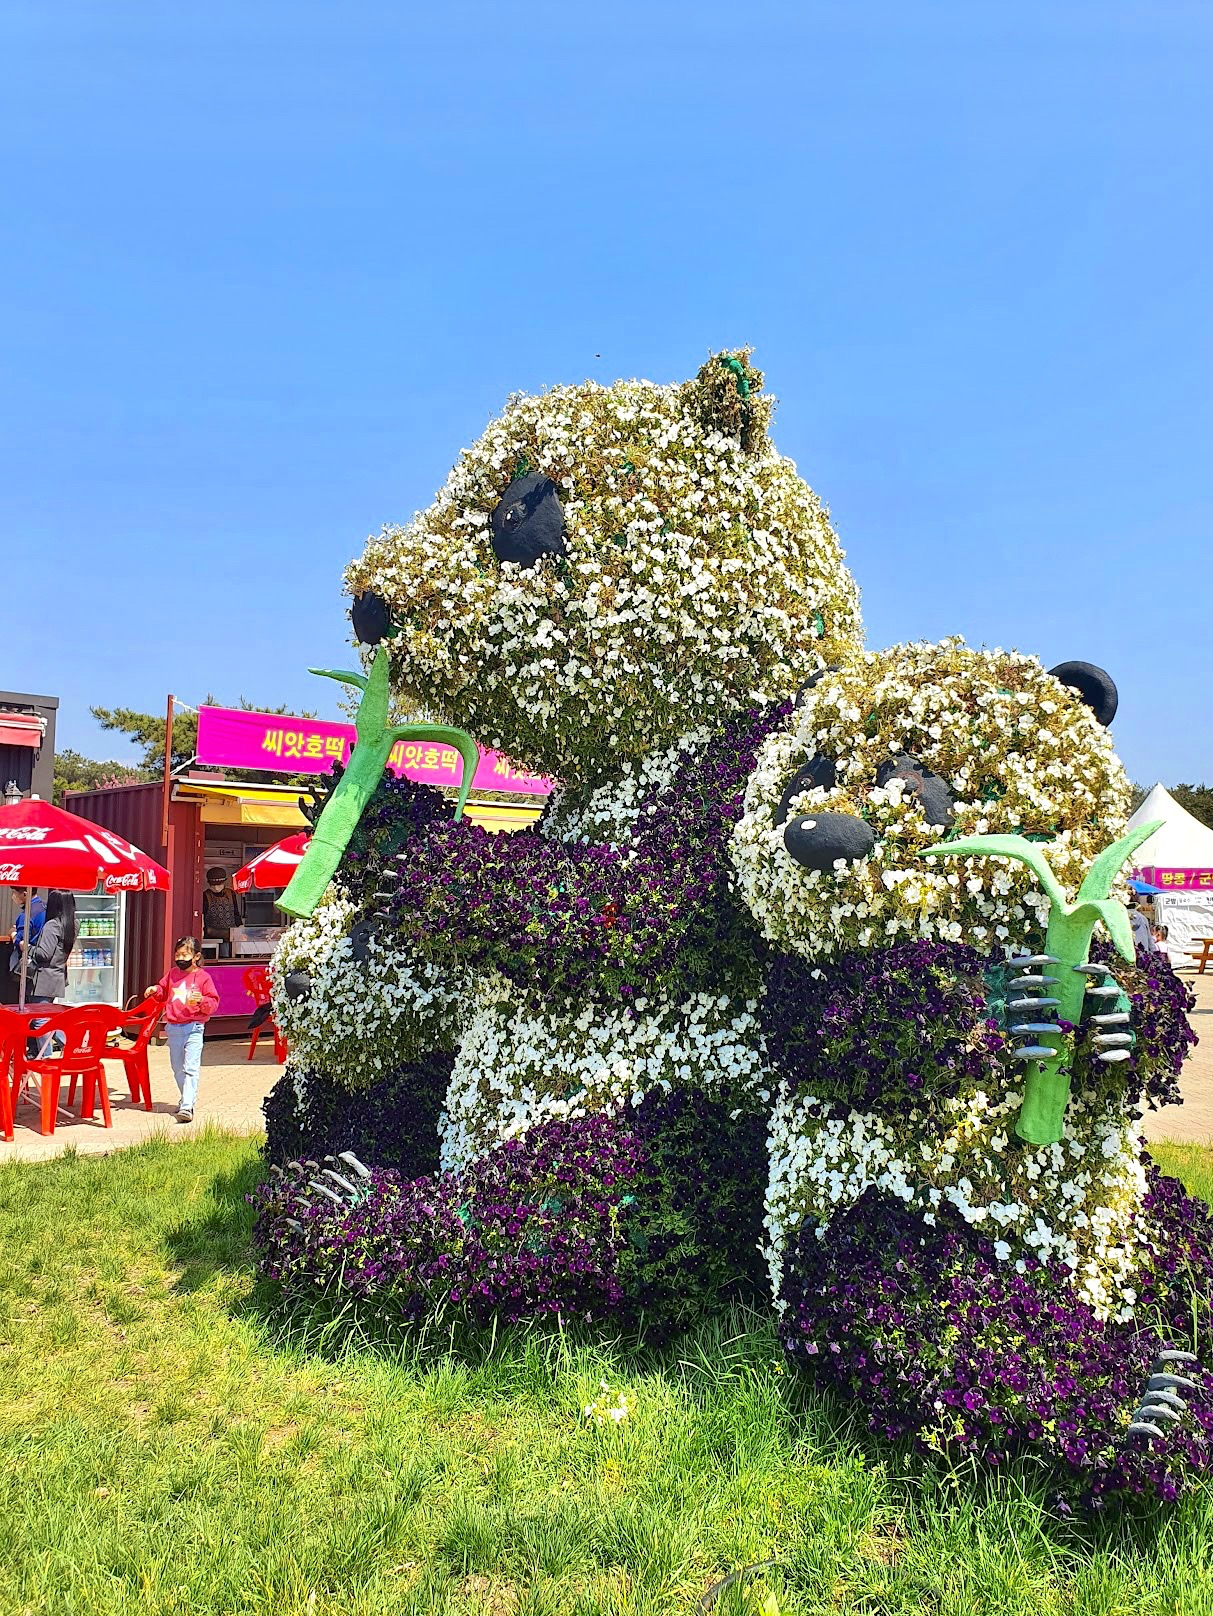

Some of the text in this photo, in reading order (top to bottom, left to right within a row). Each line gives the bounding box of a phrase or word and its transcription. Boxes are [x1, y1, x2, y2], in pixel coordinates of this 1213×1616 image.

[262, 731, 345, 761] 씨앗호떡
[106, 873, 139, 888] Coca-Cola
[1199, 873, 1213, 885] 군
